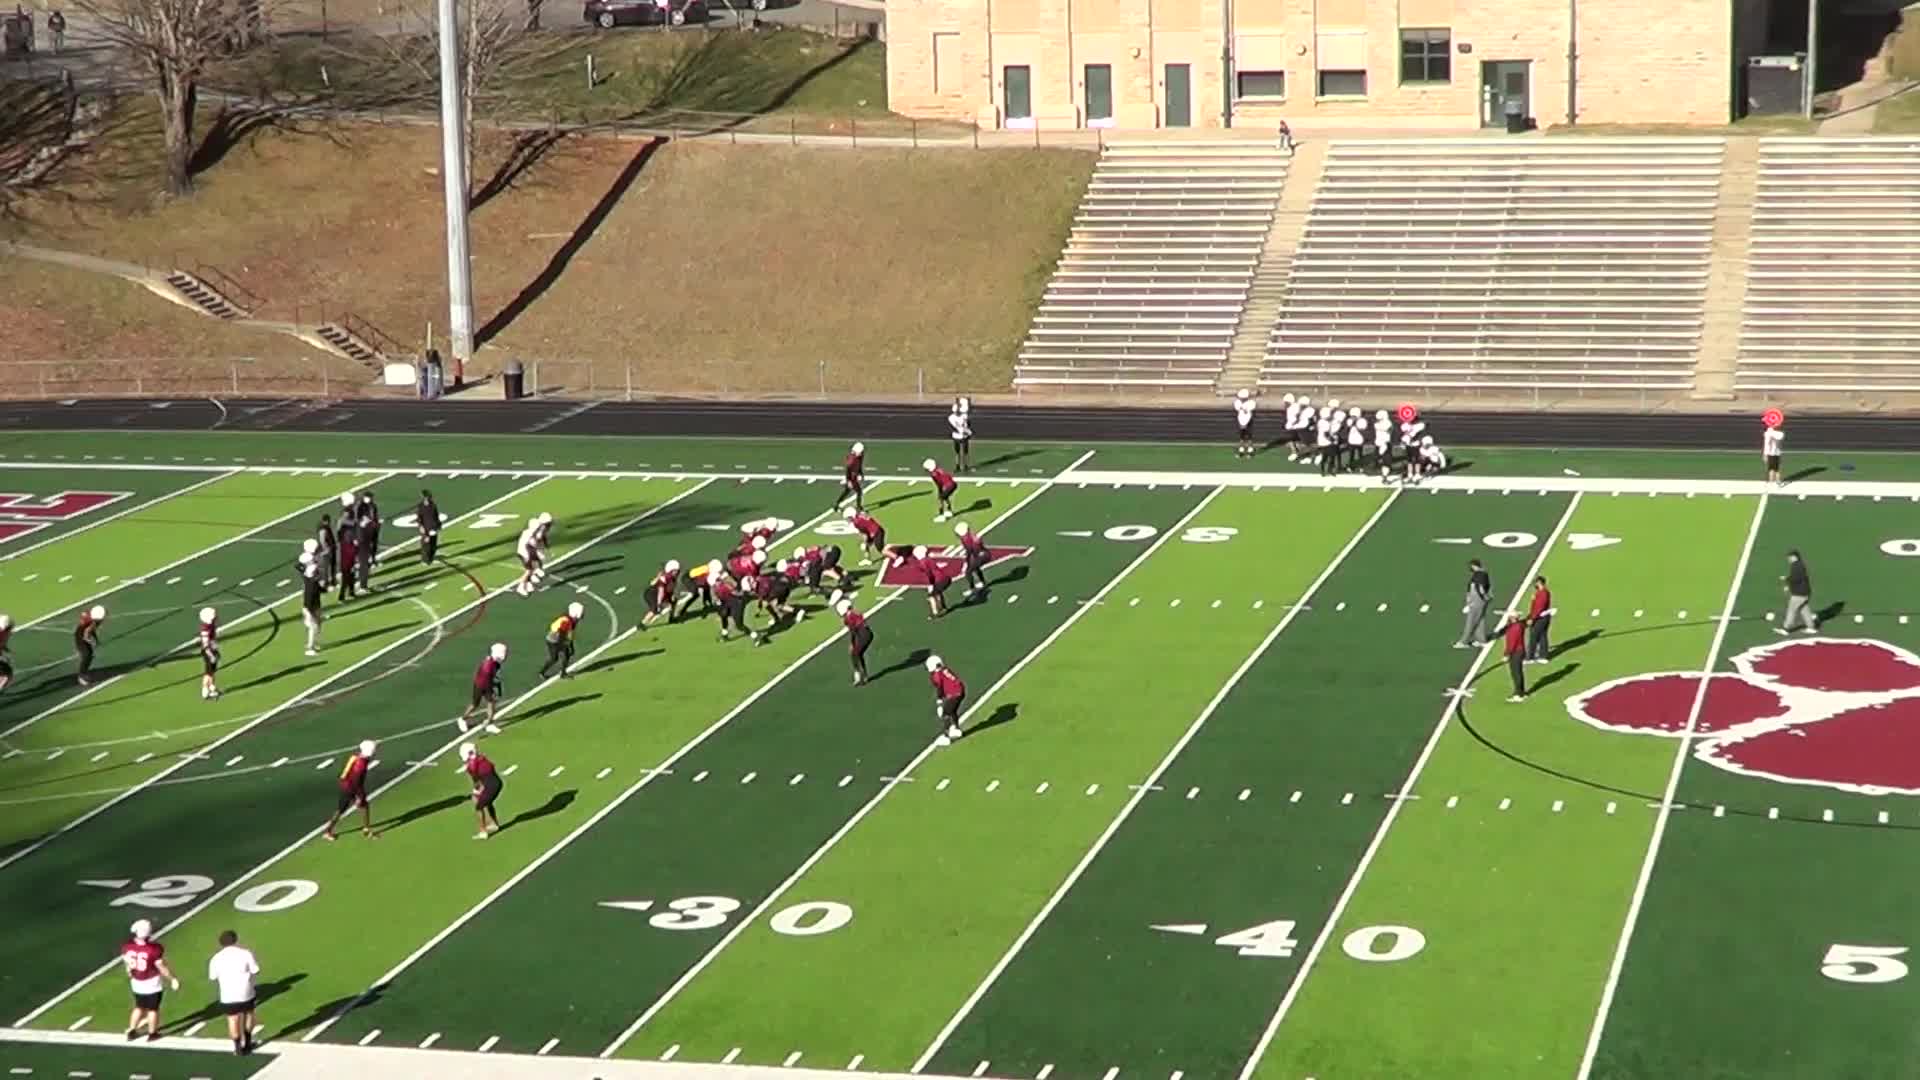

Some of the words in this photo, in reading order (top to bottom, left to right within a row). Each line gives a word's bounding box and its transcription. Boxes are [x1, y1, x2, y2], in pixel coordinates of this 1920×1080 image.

[649, 896, 853, 935] 30
[1215, 920, 1426, 961] 40
[1820, 944, 1910, 983] 5
